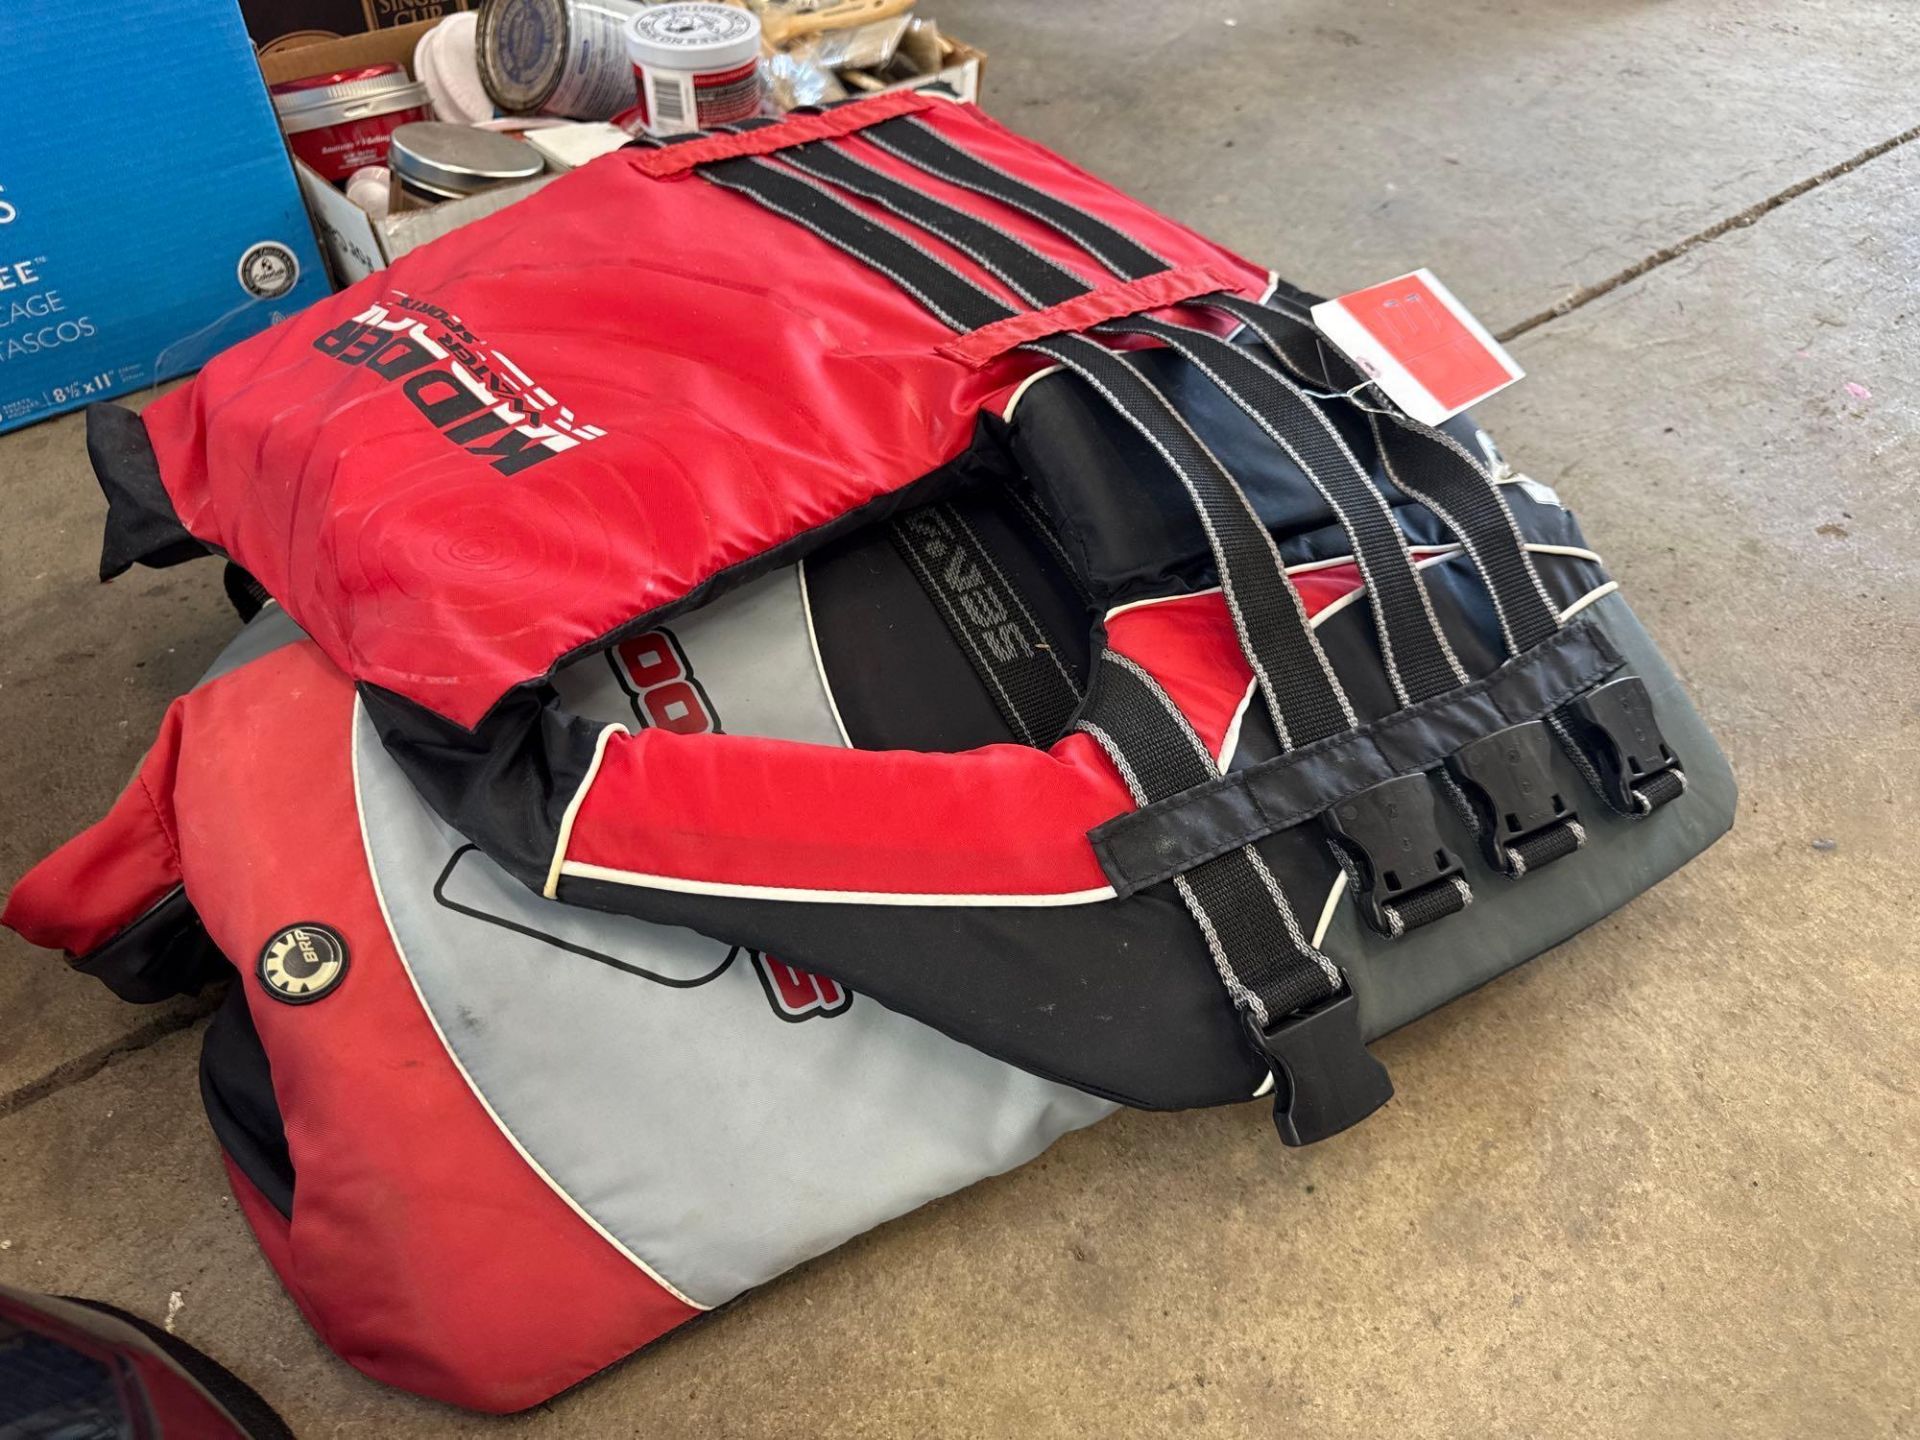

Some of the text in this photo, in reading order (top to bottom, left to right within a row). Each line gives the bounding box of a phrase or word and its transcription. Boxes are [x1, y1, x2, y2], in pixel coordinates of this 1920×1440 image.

[396, 296, 481, 344] SPORTS
[312, 304, 582, 478] KIDDER
[437, 334, 540, 428] WATER
[294, 928, 319, 963] BRP
